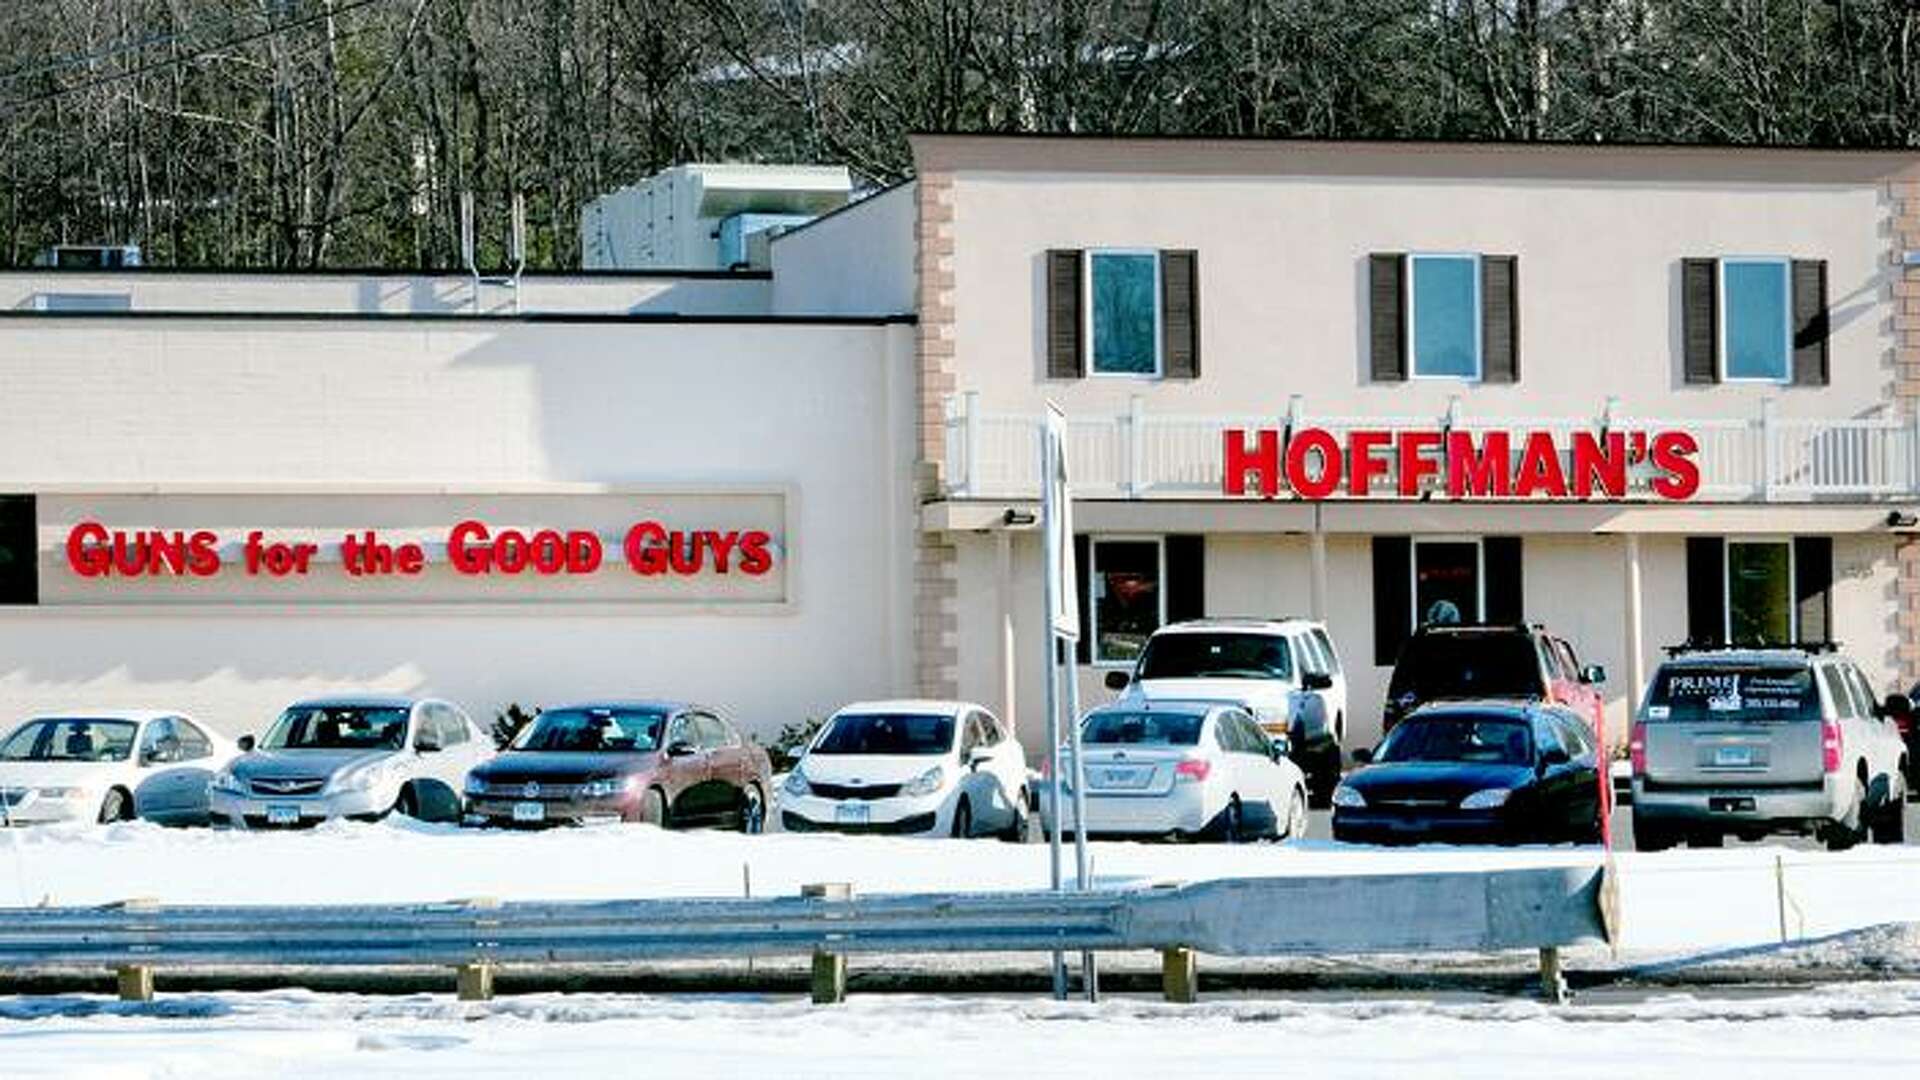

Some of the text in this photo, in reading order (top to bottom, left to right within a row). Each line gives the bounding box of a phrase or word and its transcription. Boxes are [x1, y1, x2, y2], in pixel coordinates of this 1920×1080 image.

[1224, 427, 1701, 501] HOFFMAN'S
[66, 520, 773, 579] GUNS for the GOOD GUYS
